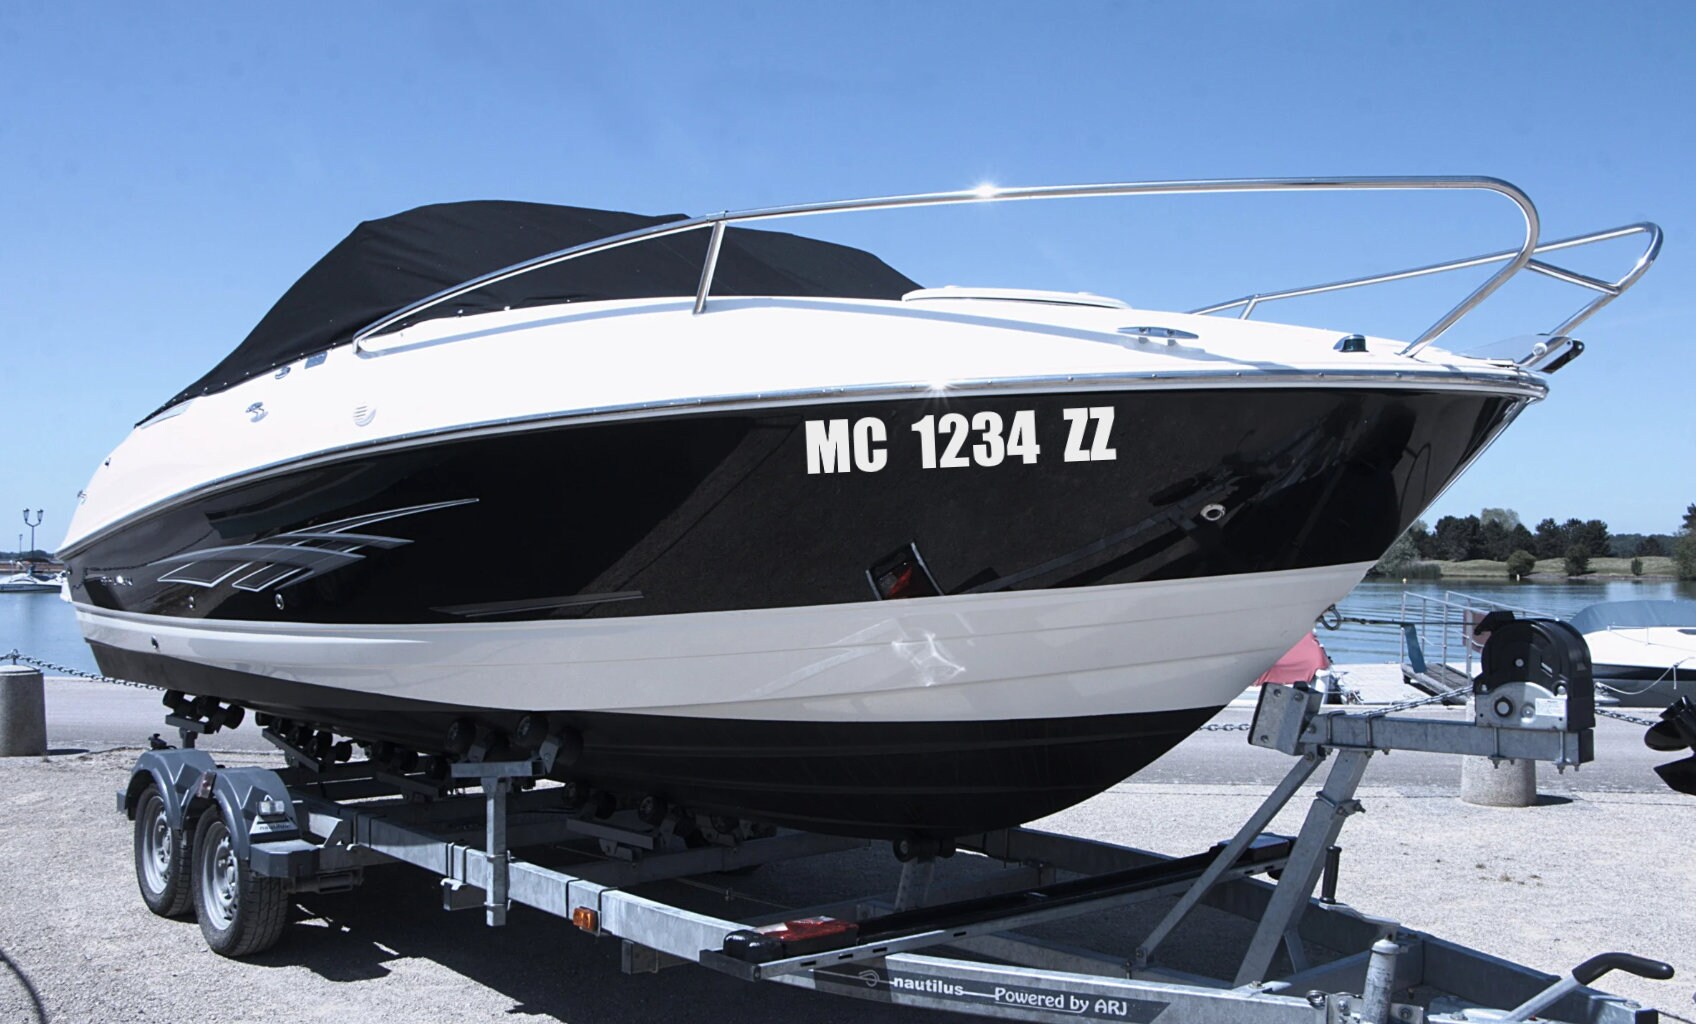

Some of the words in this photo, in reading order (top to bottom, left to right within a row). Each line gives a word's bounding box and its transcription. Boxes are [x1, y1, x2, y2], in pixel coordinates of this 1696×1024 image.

[805, 416, 888, 474] MC
[911, 410, 1041, 469] 1234
[1063, 406, 1117, 463] ZZ
[893, 976, 964, 996] nautilus
[994, 986, 1065, 1008] Powered
[1069, 995, 1090, 1013] by
[1093, 998, 1128, 1016] ARJ
